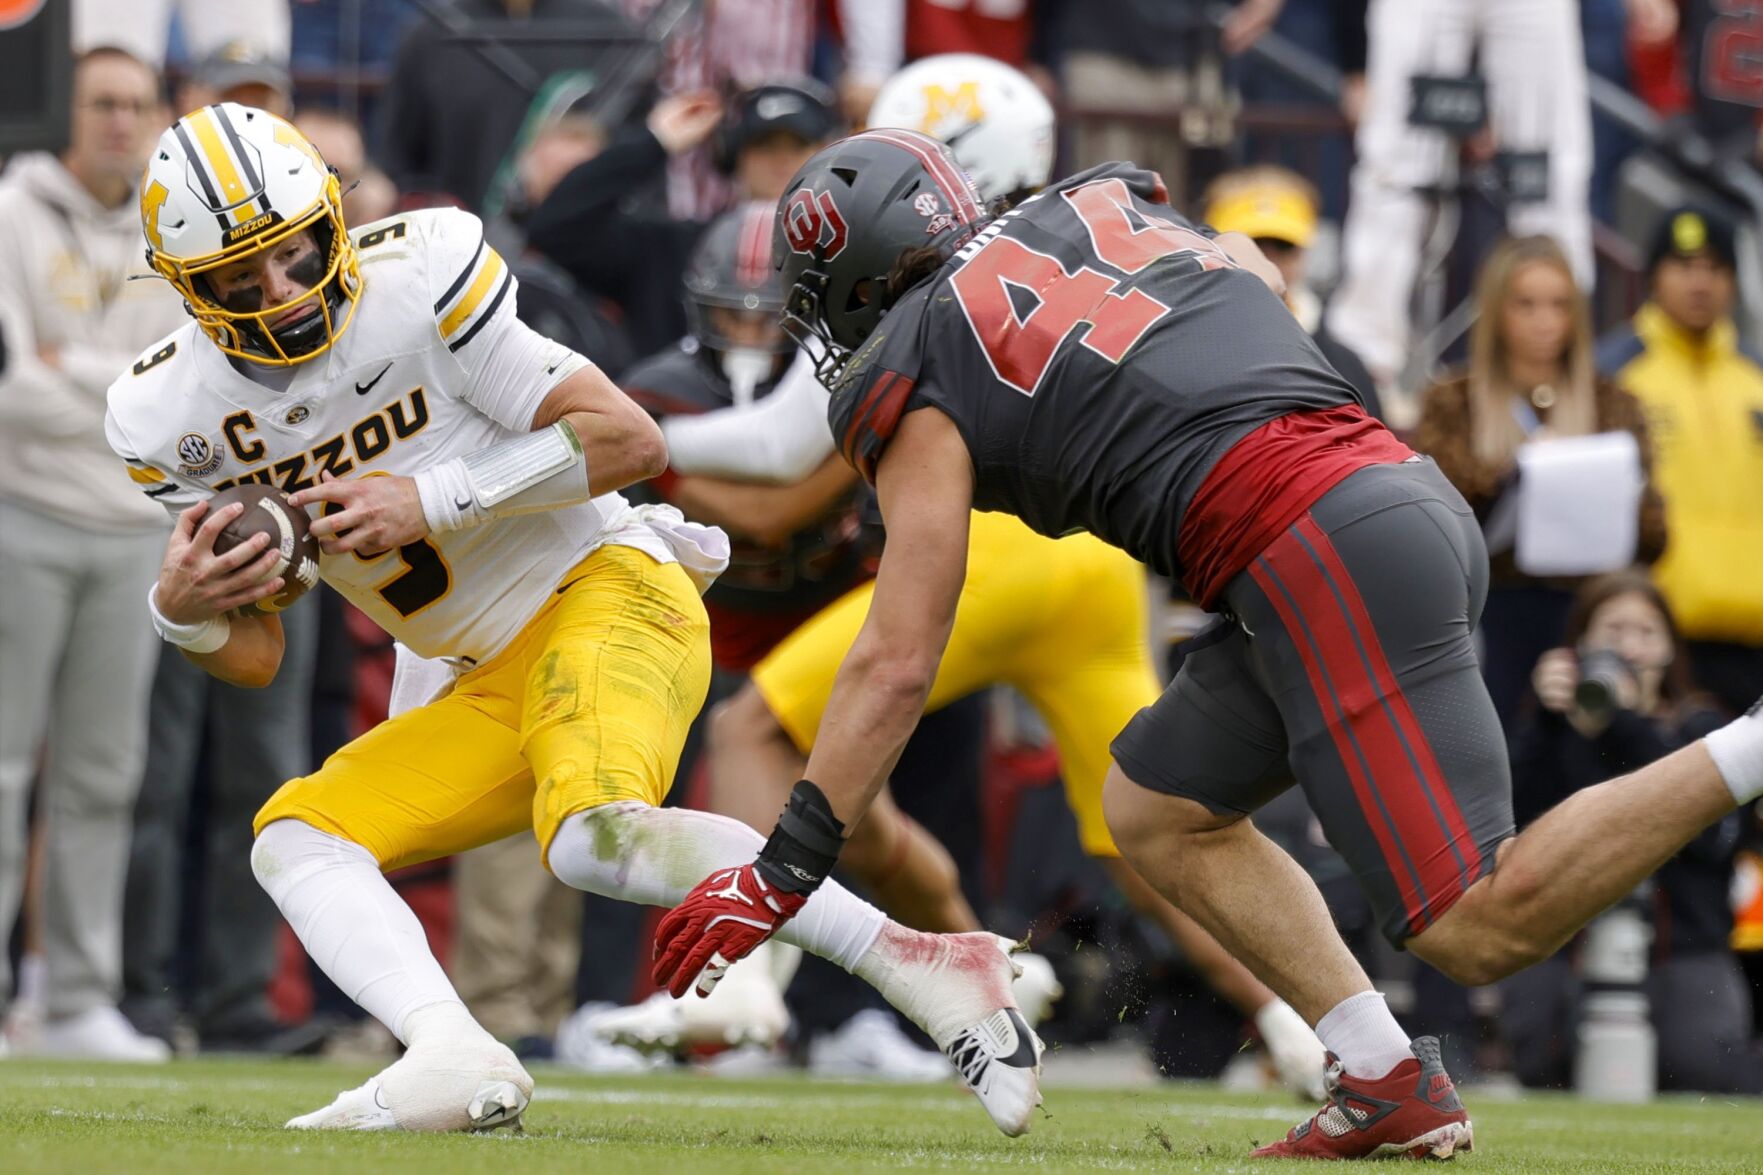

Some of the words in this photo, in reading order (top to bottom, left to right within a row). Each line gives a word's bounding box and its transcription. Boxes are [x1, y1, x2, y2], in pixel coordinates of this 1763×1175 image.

[920, 82, 985, 123] M
[229, 213, 273, 241] MIZZOU
[358, 221, 407, 250] 9
[949, 180, 1241, 397] 44
[132, 340, 177, 376] 9
[179, 434, 209, 464] SEC
[221, 409, 269, 466] C
[186, 454, 222, 477] GRADUATE
